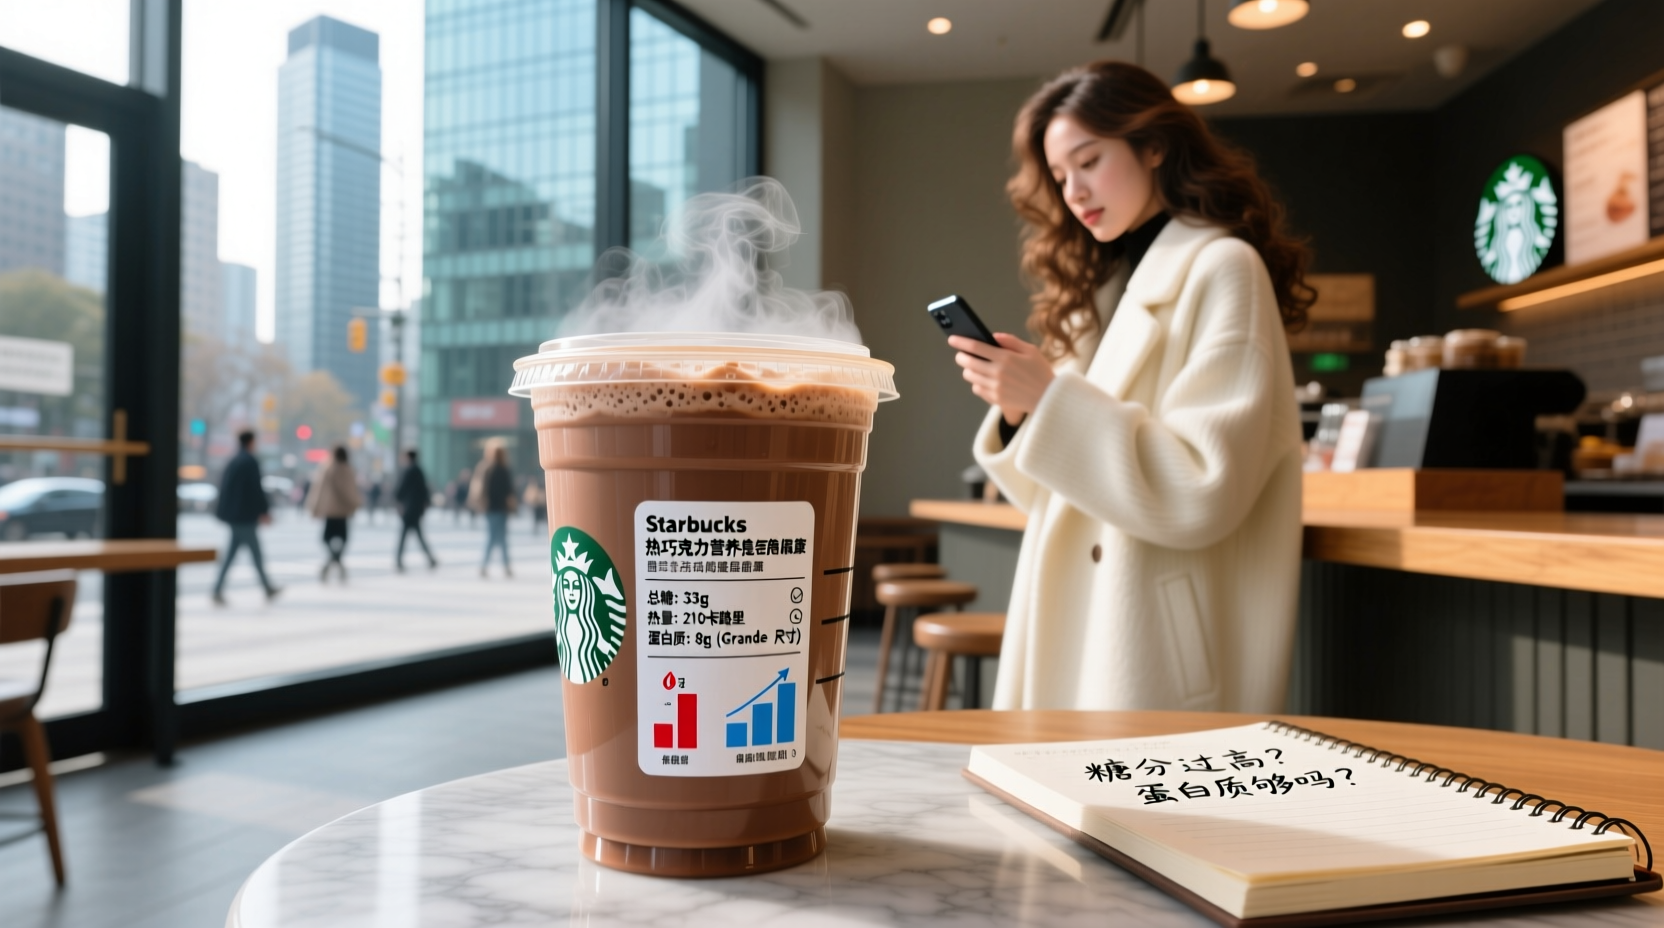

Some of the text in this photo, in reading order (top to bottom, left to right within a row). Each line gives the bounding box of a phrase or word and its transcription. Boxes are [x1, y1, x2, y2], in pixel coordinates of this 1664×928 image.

[646, 515, 747, 533] Starbucks
[683, 592, 709, 608] 33g
[695, 632, 712, 649] 8g
[717, 630, 768, 648] (Grande
[774, 628, 801, 645] 尺寸)
[1085, 748, 1284, 783] 糖分过高?
[1136, 768, 1357, 804] 蛋白质够吗?
